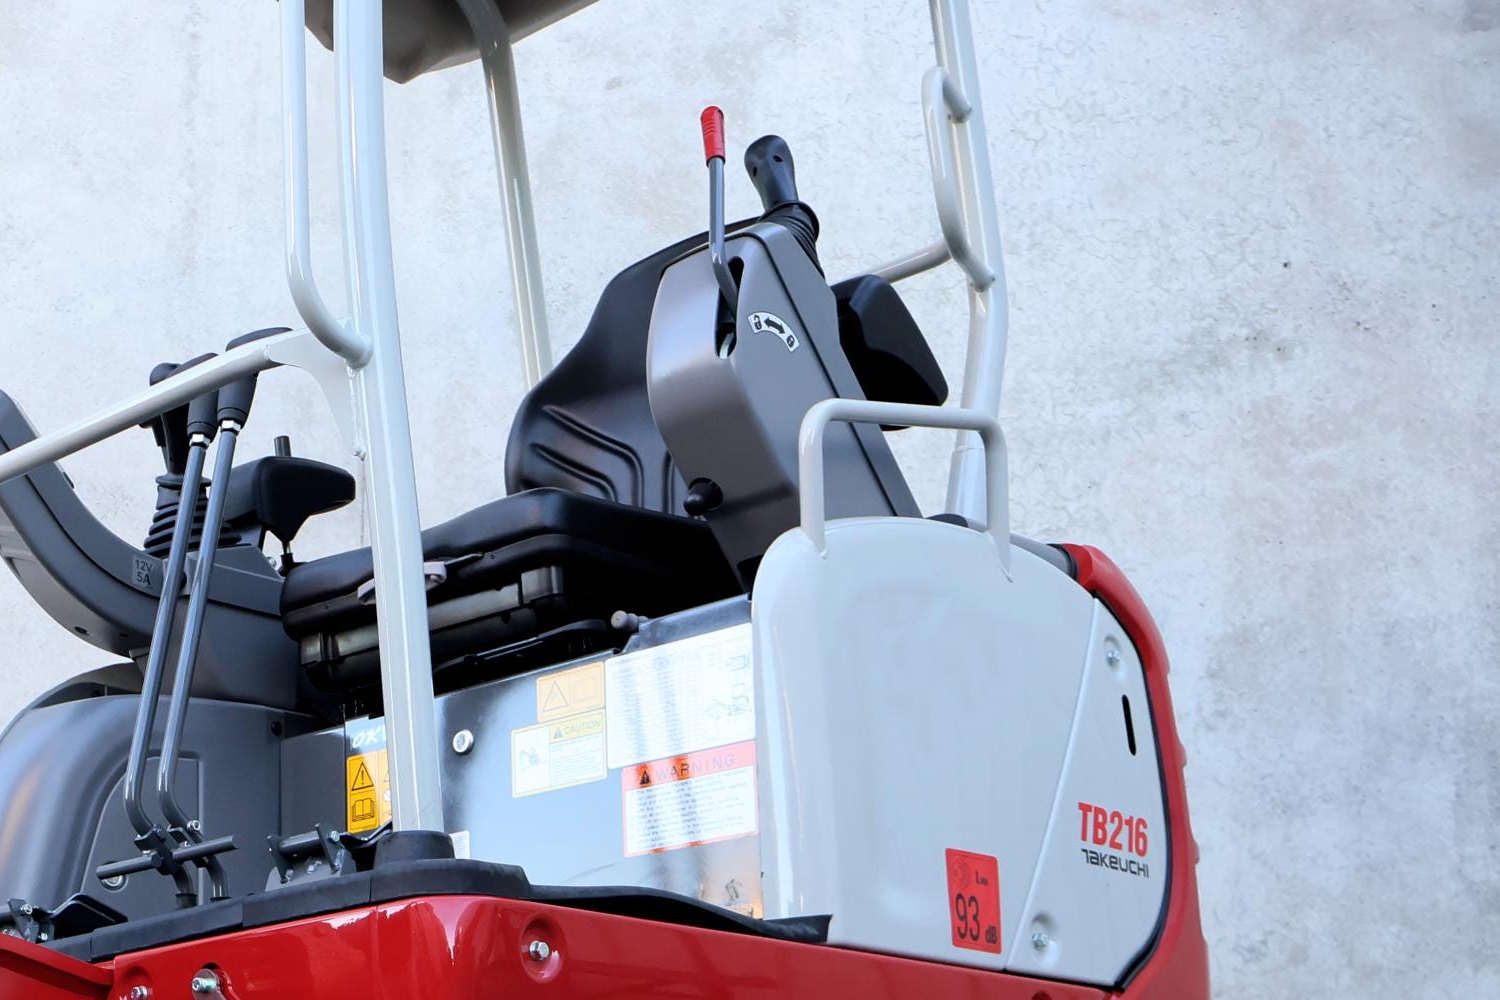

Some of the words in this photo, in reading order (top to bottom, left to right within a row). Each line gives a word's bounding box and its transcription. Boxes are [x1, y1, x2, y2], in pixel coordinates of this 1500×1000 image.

[136, 571, 151, 585] 5A
[563, 719, 601, 735] CAUTION
[656, 753, 736, 780] WARNING
[1077, 801, 1149, 857] TB216
[955, 892, 980, 942] 93
[984, 924, 998, 945] dB
